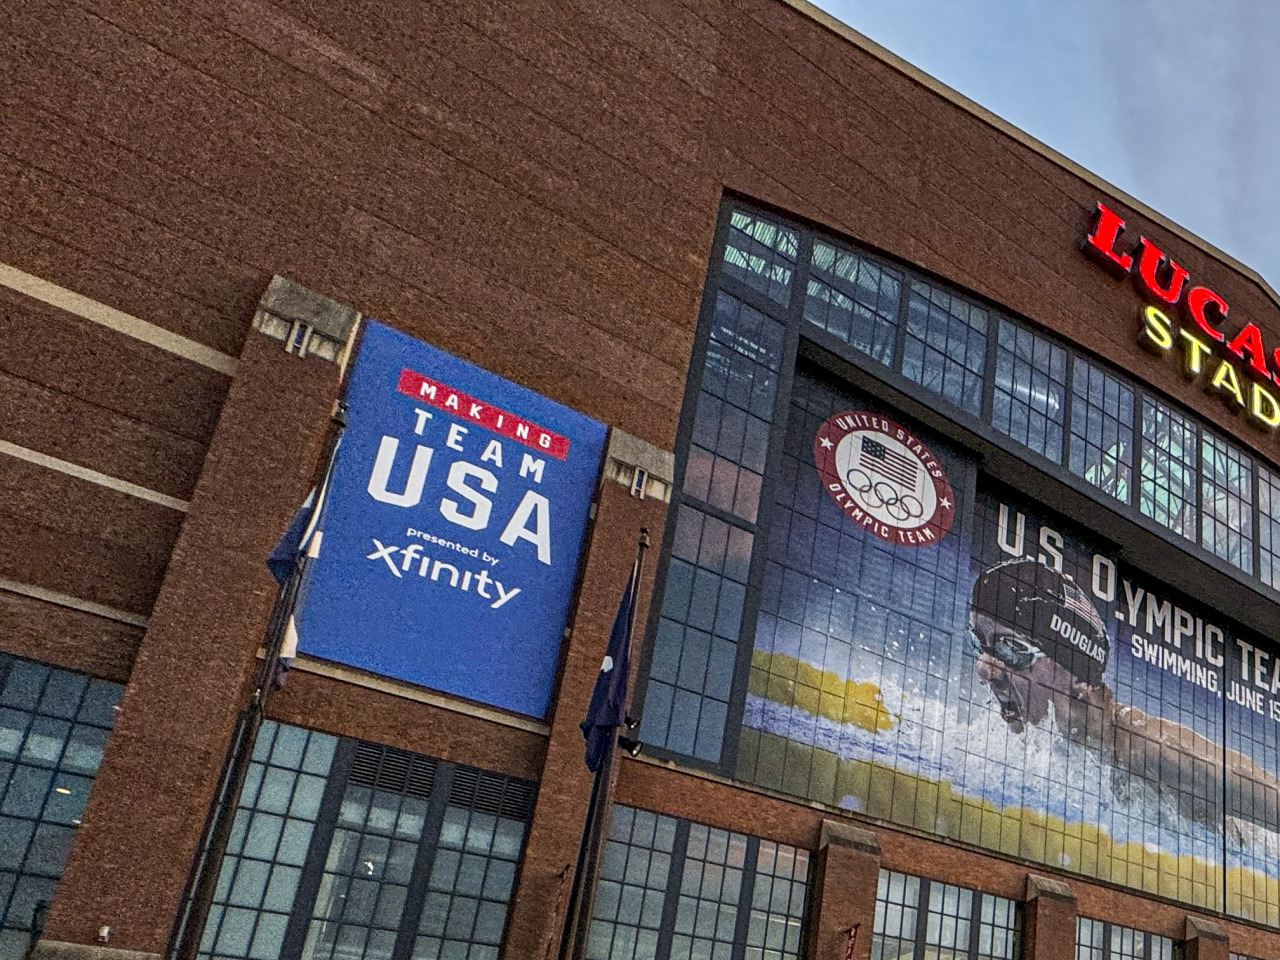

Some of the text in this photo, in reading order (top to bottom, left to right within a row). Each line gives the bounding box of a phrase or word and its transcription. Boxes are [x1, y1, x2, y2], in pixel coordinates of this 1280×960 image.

[413, 408, 545, 484] TEAM
[419, 381, 551, 449] MAKING
[835, 414, 943, 479] UNITED STATES
[367, 435, 552, 566] USA
[828, 482, 936, 544] OLYMPIC TEAM
[366, 538, 522, 609] xfinity
[406, 527, 500, 567] presented by
[997, 502, 1074, 582] U.S.
[1092, 553, 1225, 668] OYMPIC
[1131, 633, 1222, 699] SWIMMING,
[1226, 680, 1265, 716] JUNE
